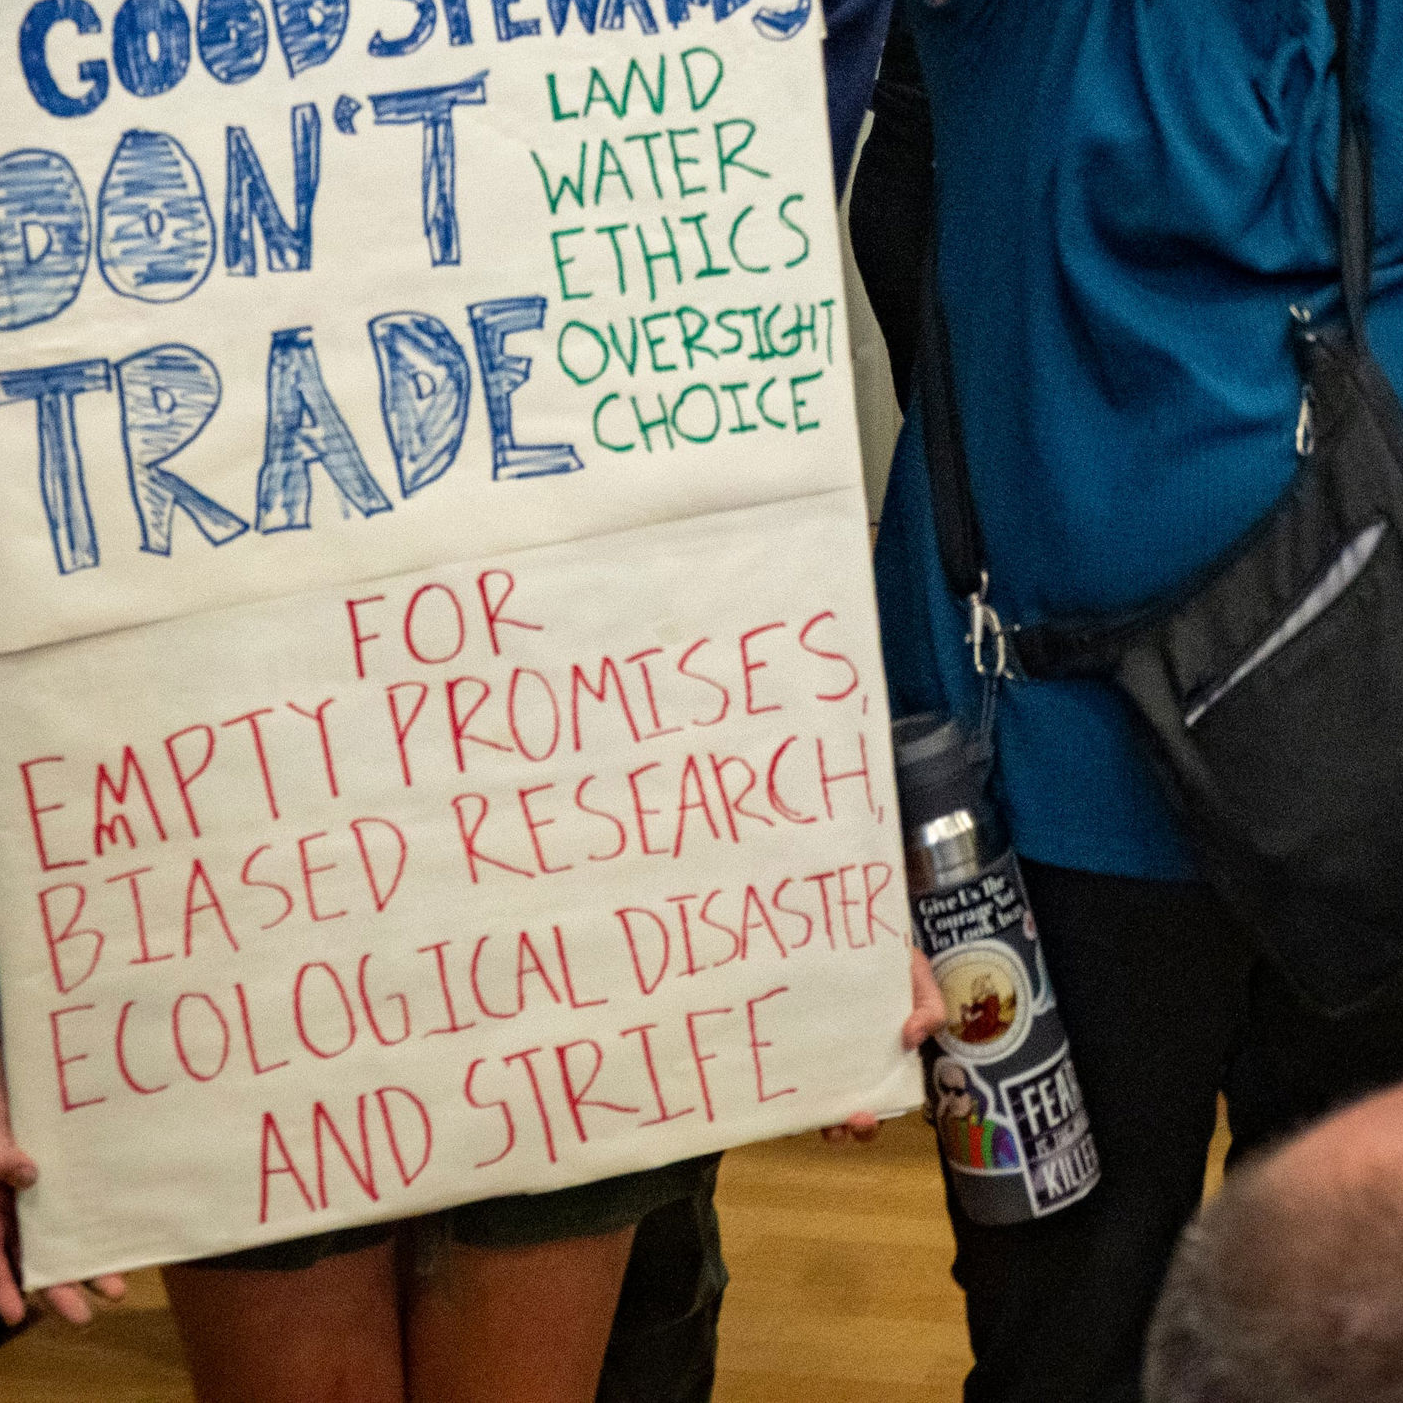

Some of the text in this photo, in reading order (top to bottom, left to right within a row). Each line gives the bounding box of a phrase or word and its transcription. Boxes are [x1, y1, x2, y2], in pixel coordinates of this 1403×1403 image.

[546, 47, 724, 122] LAND
[530, 118, 771, 216] WATER
[550, 194, 811, 302] ETHICS
[557, 299, 836, 386] OVERSIGHT
[592, 371, 825, 454] CHOICE
[347, 568, 544, 680] FOR
[18, 610, 870, 874] EMPTY PROMISES,
[38, 731, 886, 996] BIASED RESEARCH,
[919, 896, 958, 917] Give
[49, 924, 609, 1114] ECOLOGICAL
[257, 985, 799, 1225] AND STRIFE
